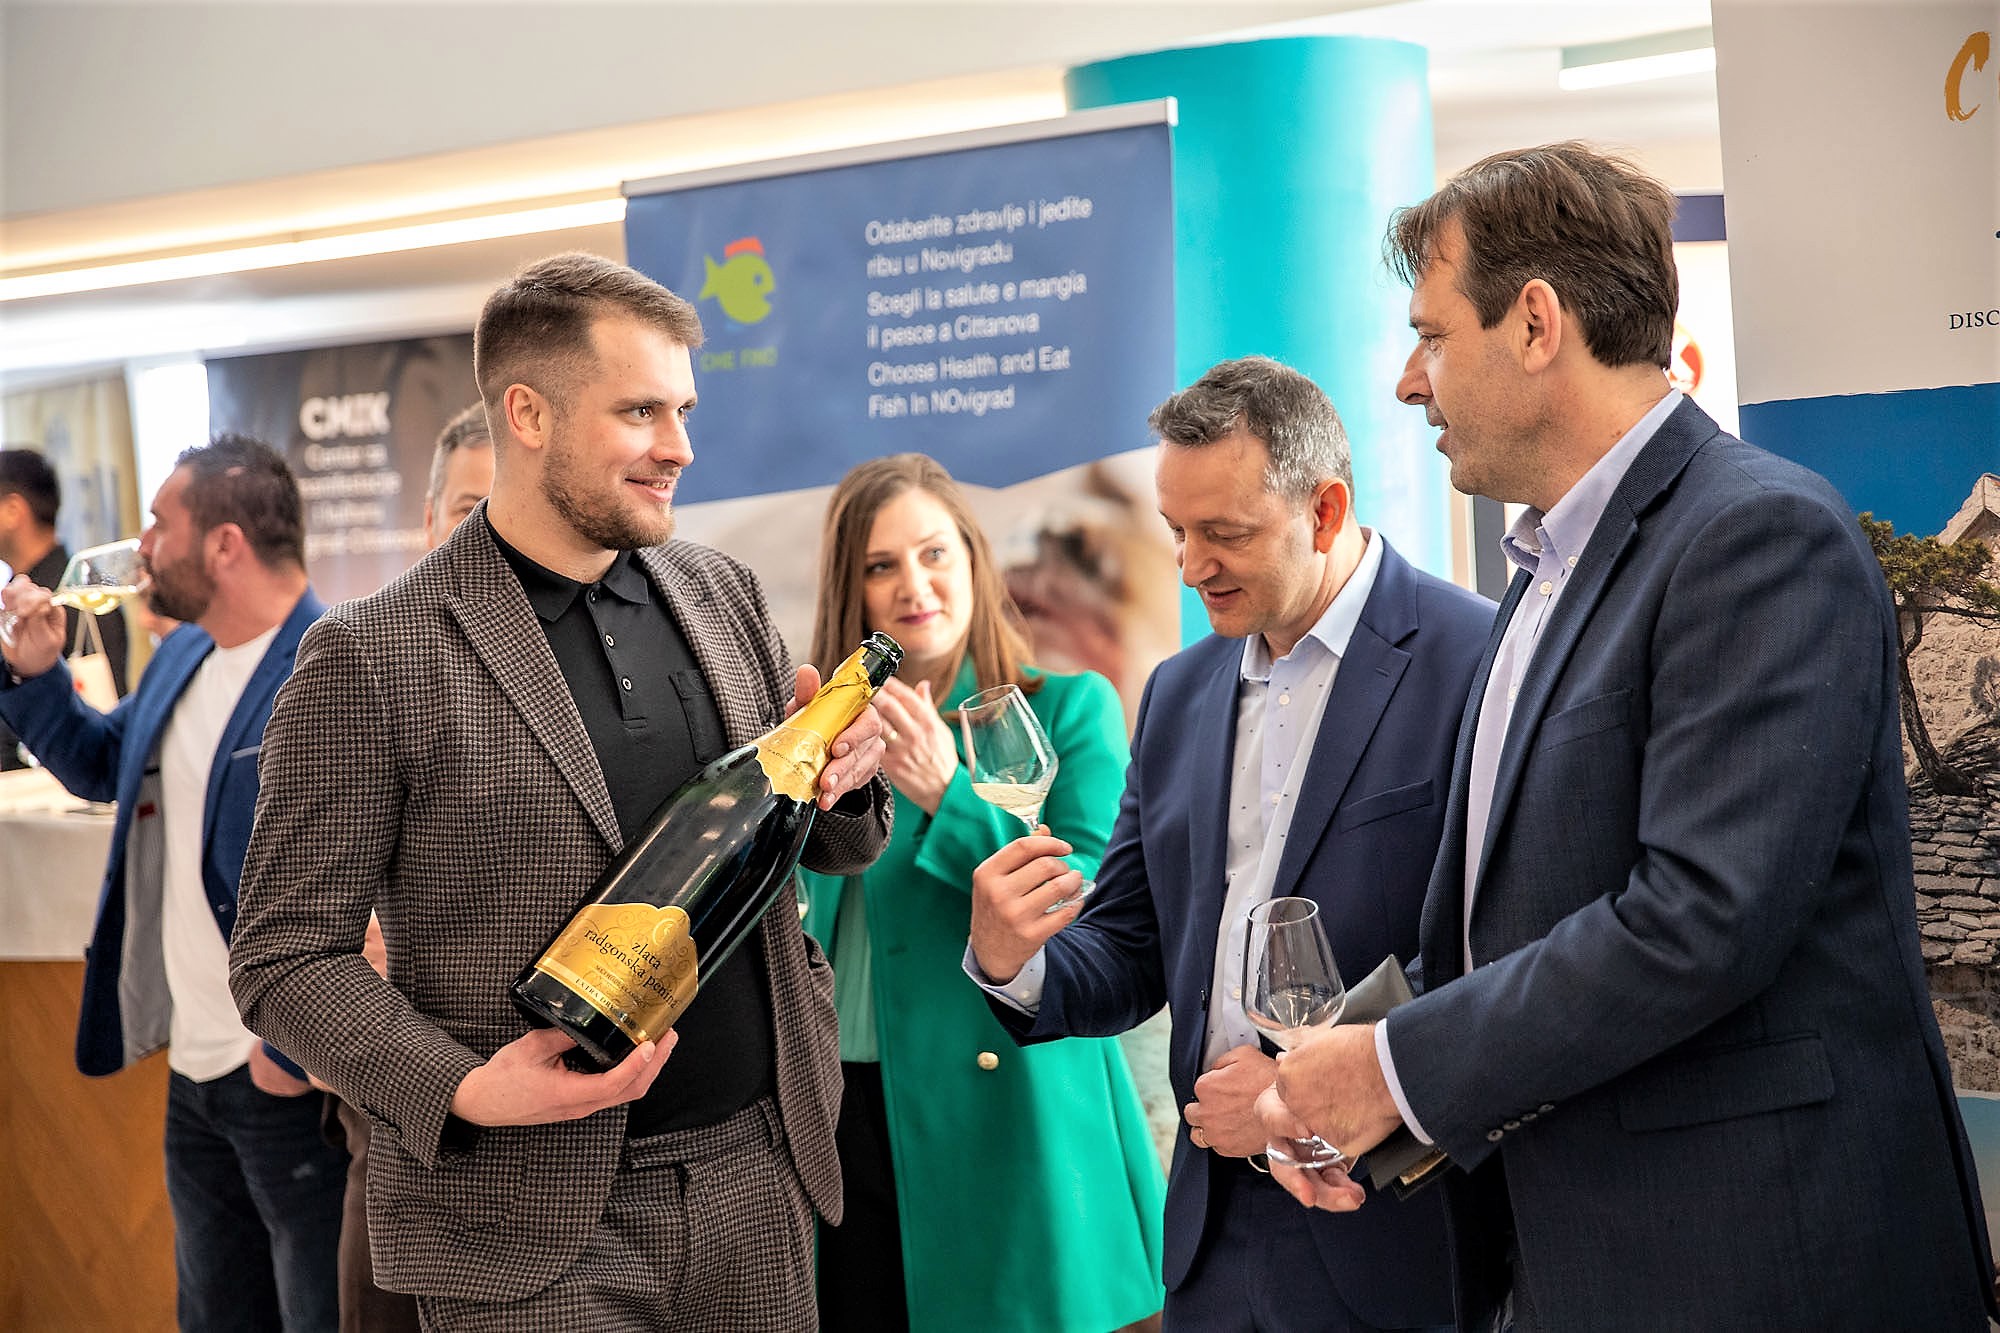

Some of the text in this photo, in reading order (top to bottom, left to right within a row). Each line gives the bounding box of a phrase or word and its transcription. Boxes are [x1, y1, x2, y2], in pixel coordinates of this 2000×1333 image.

[1944, 31, 2000, 121] C
[865, 195, 1093, 246] Odaberite zdravlje i jedite
[866, 239, 1014, 279] ribu u Novigradu
[866, 269, 1087, 319] Scegli la salute e mangia
[881, 323, 937, 351] pesce
[938, 321, 952, 342] a
[954, 313, 1040, 341] Cittanova
[867, 345, 1071, 387] Choose Health and Eat
[868, 393, 907, 419] Fish
[930, 384, 1015, 417] NOvigrad
[584, 930, 646, 978] radgonska
[643, 975, 678, 1008] penina
[632, 943, 661, 969] zlata
[575, 978, 599, 998] EXTRA
